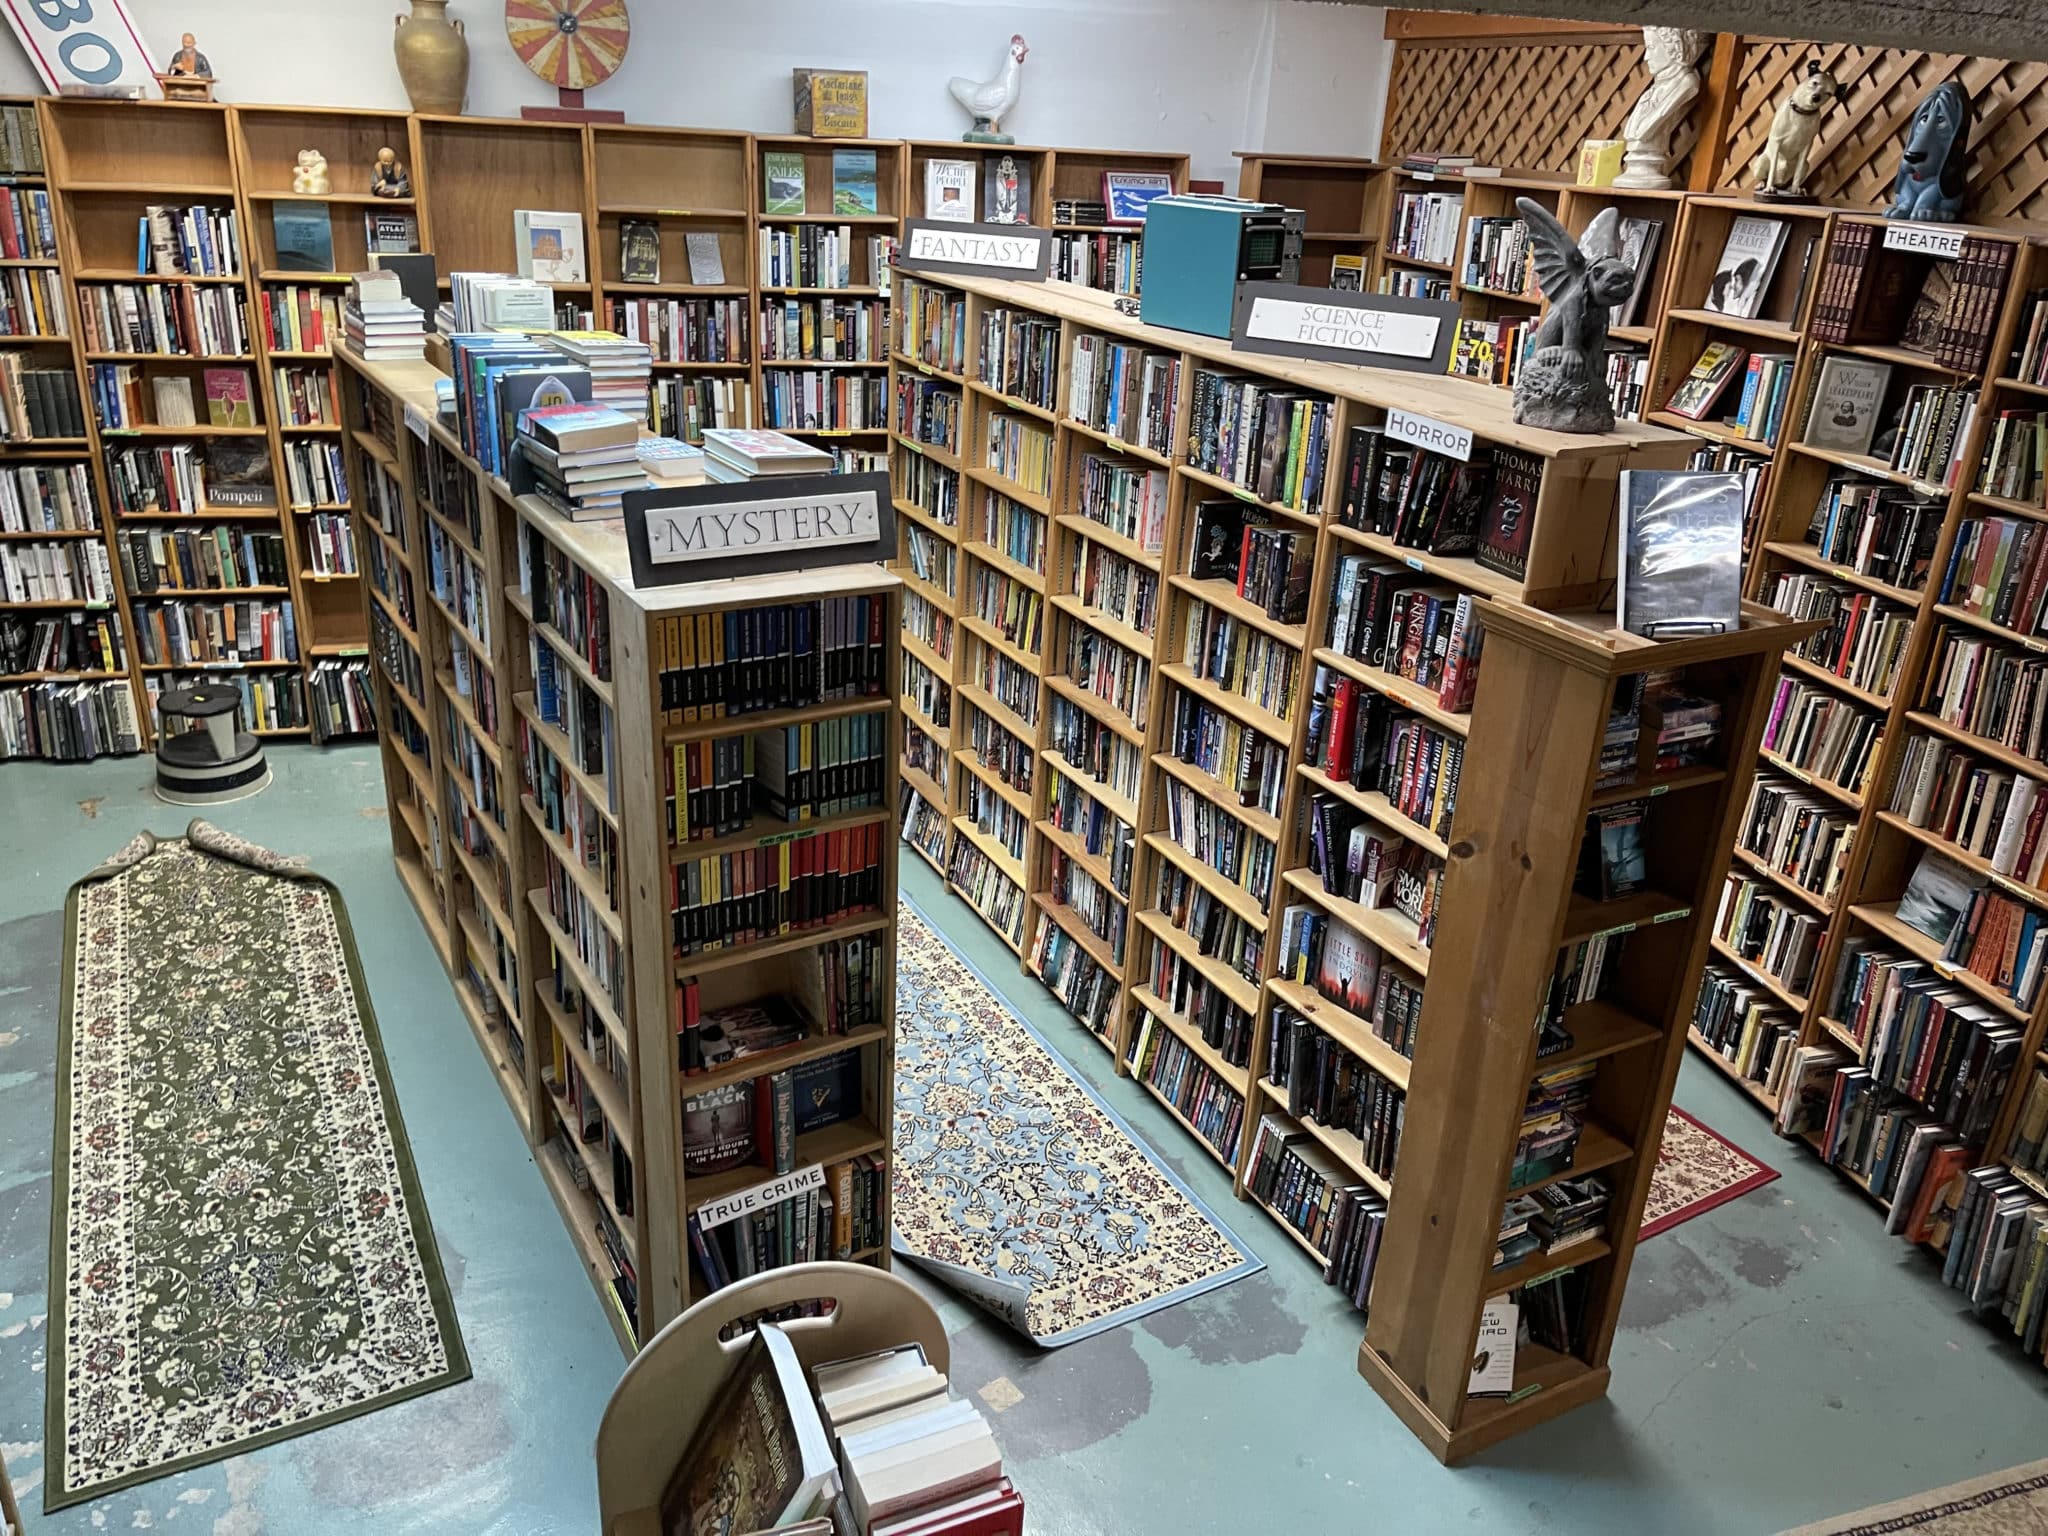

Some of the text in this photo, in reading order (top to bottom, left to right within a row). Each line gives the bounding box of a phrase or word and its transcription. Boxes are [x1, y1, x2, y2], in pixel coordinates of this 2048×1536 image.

[823, 116, 857, 129] Biscuits
[936, 175, 969, 186] PEOPLE
[379, 224, 406, 234] ATLAS
[1888, 229, 1961, 253] THEATRE
[920, 235, 1031, 265] FANTASY
[1302, 306, 1386, 330] SCIENCE
[1297, 325, 1383, 349] FICTION
[1197, 373, 1205, 405] LEGACY
[1947, 391, 1963, 436] LAURENCE
[1389, 412, 1469, 454] HORROR
[1492, 449, 1543, 478] THOMAS
[1496, 467, 1538, 494] HARRI
[209, 488, 264, 504] Pompeii
[665, 502, 862, 552] MYSTERY
[134, 542, 149, 584] SWORD
[1477, 541, 1528, 570] HANNIBA
[1449, 599, 1468, 660] STEPHEN KING
[1408, 725, 1419, 757] STEPHEN
[1419, 741, 1430, 770] STEPHEN
[1432, 741, 1443, 770] STEPHEN
[1445, 746, 1456, 776] STEPHEN
[1448, 748, 1462, 801] STEPHEN KING
[686, 1090, 746, 1113] BLACK
[685, 1139, 749, 1159] THREE HOURS
[696, 1149, 739, 1164] IN PARIS
[701, 1169, 822, 1225] TRUE CRIME
